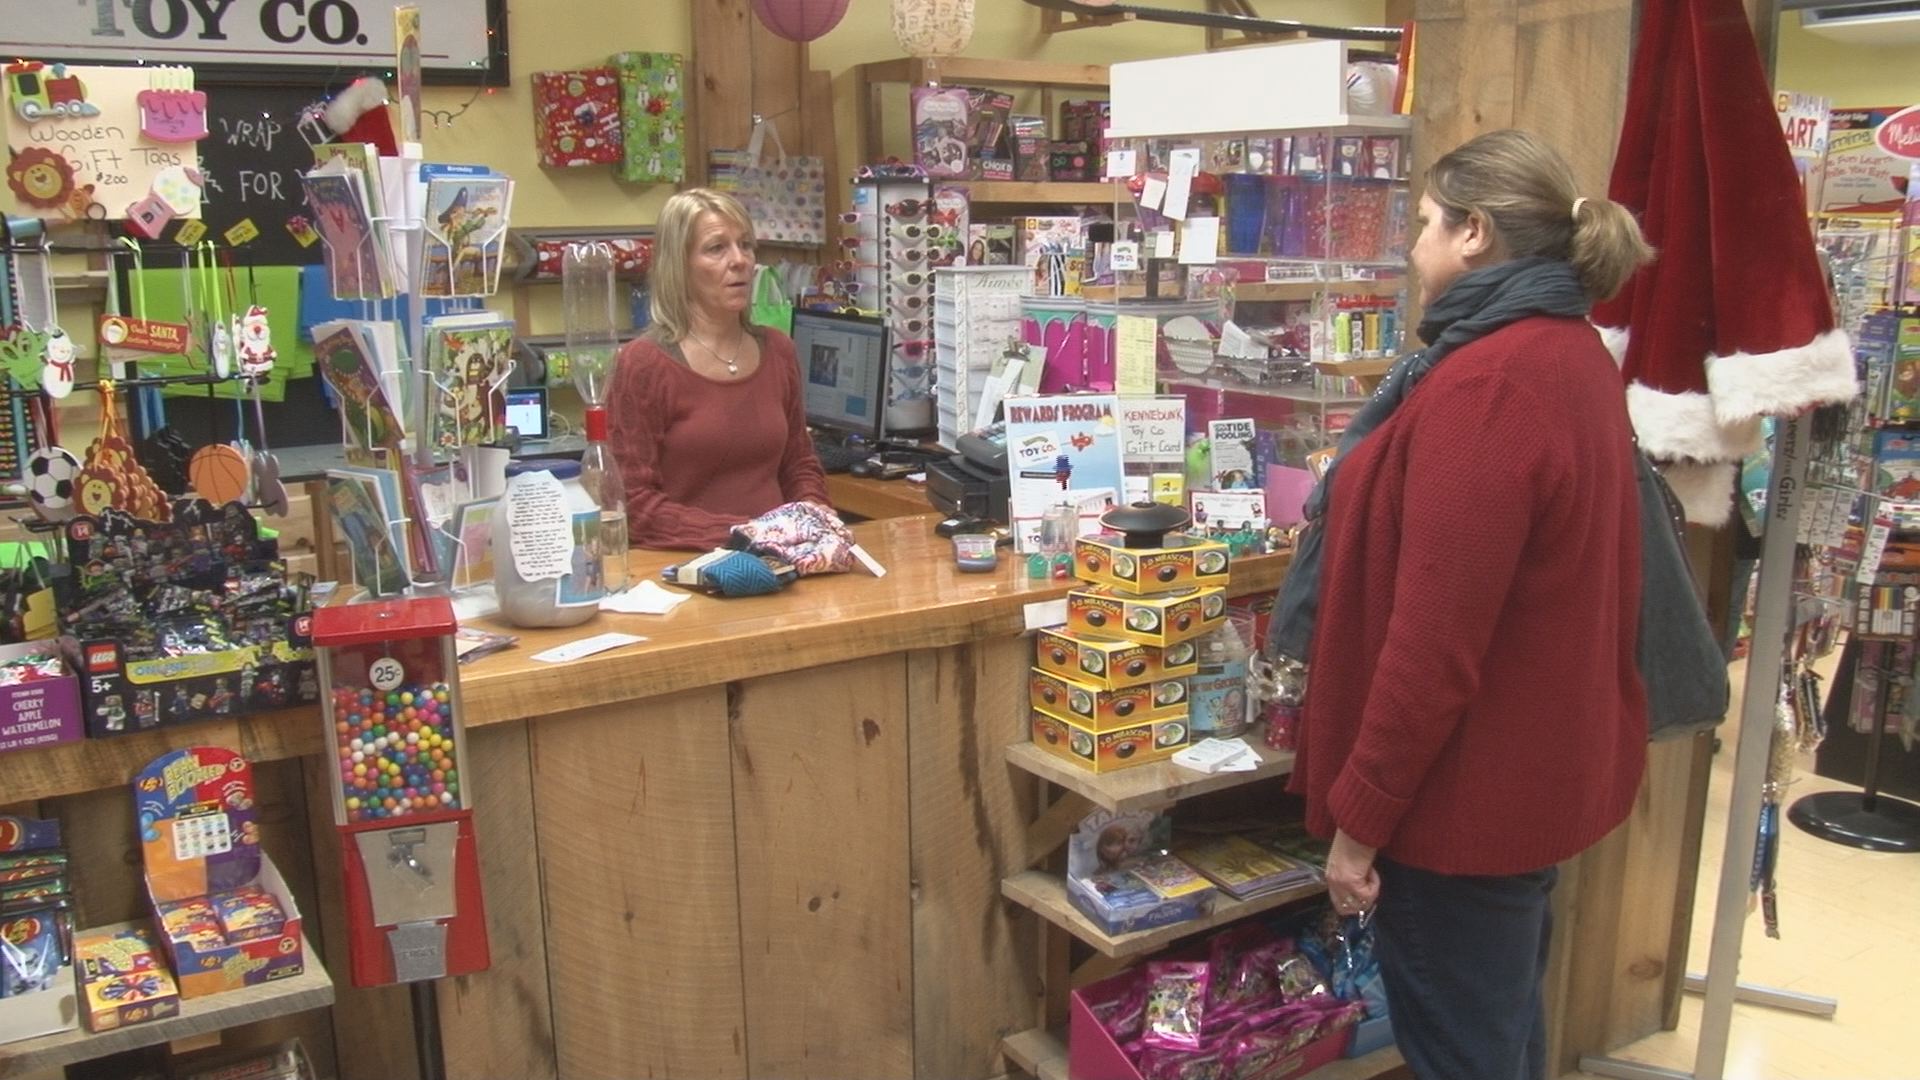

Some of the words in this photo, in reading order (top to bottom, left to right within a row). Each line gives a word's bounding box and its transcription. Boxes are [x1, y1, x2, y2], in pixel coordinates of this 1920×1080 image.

[79, 0, 237, 41] TOY
[259, 0, 369, 46] CO.
[28, 124, 125, 142] Wooden
[219, 118, 282, 151] WRAP
[238, 170, 285, 203] FOR
[1009, 404, 1060, 424] REWARDS
[1061, 403, 1113, 421] PROGRAM
[1227, 422, 1251, 432] TIDE
[1027, 535, 1041, 543] TO
[92, 679, 112, 693] 5+
[12, 698, 45, 712] CHERRY
[17, 709, 42, 722] APPLE
[1, 717, 62, 736] WATERMELON
